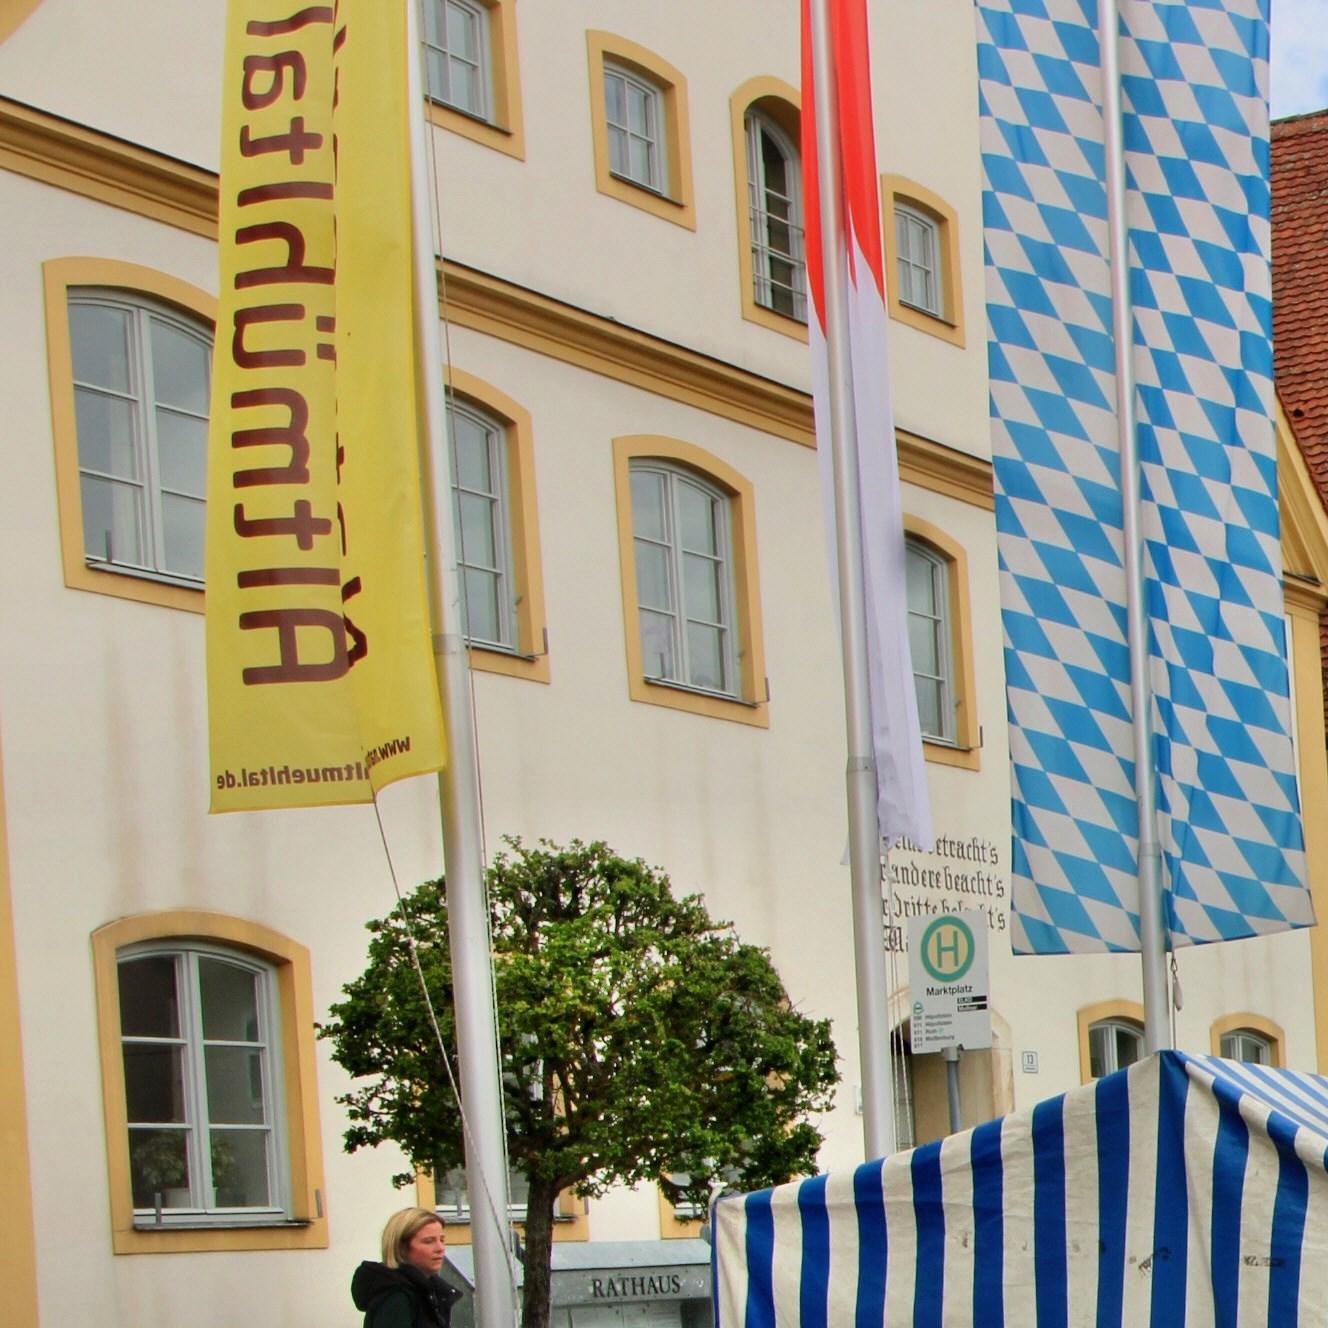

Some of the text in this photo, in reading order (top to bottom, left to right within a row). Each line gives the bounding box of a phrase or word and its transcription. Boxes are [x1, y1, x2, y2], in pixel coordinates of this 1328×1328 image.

[928, 833, 999, 865] etracht's
[926, 984, 973, 997] Marktplatz
[591, 1274, 681, 1299] RATHAUS
